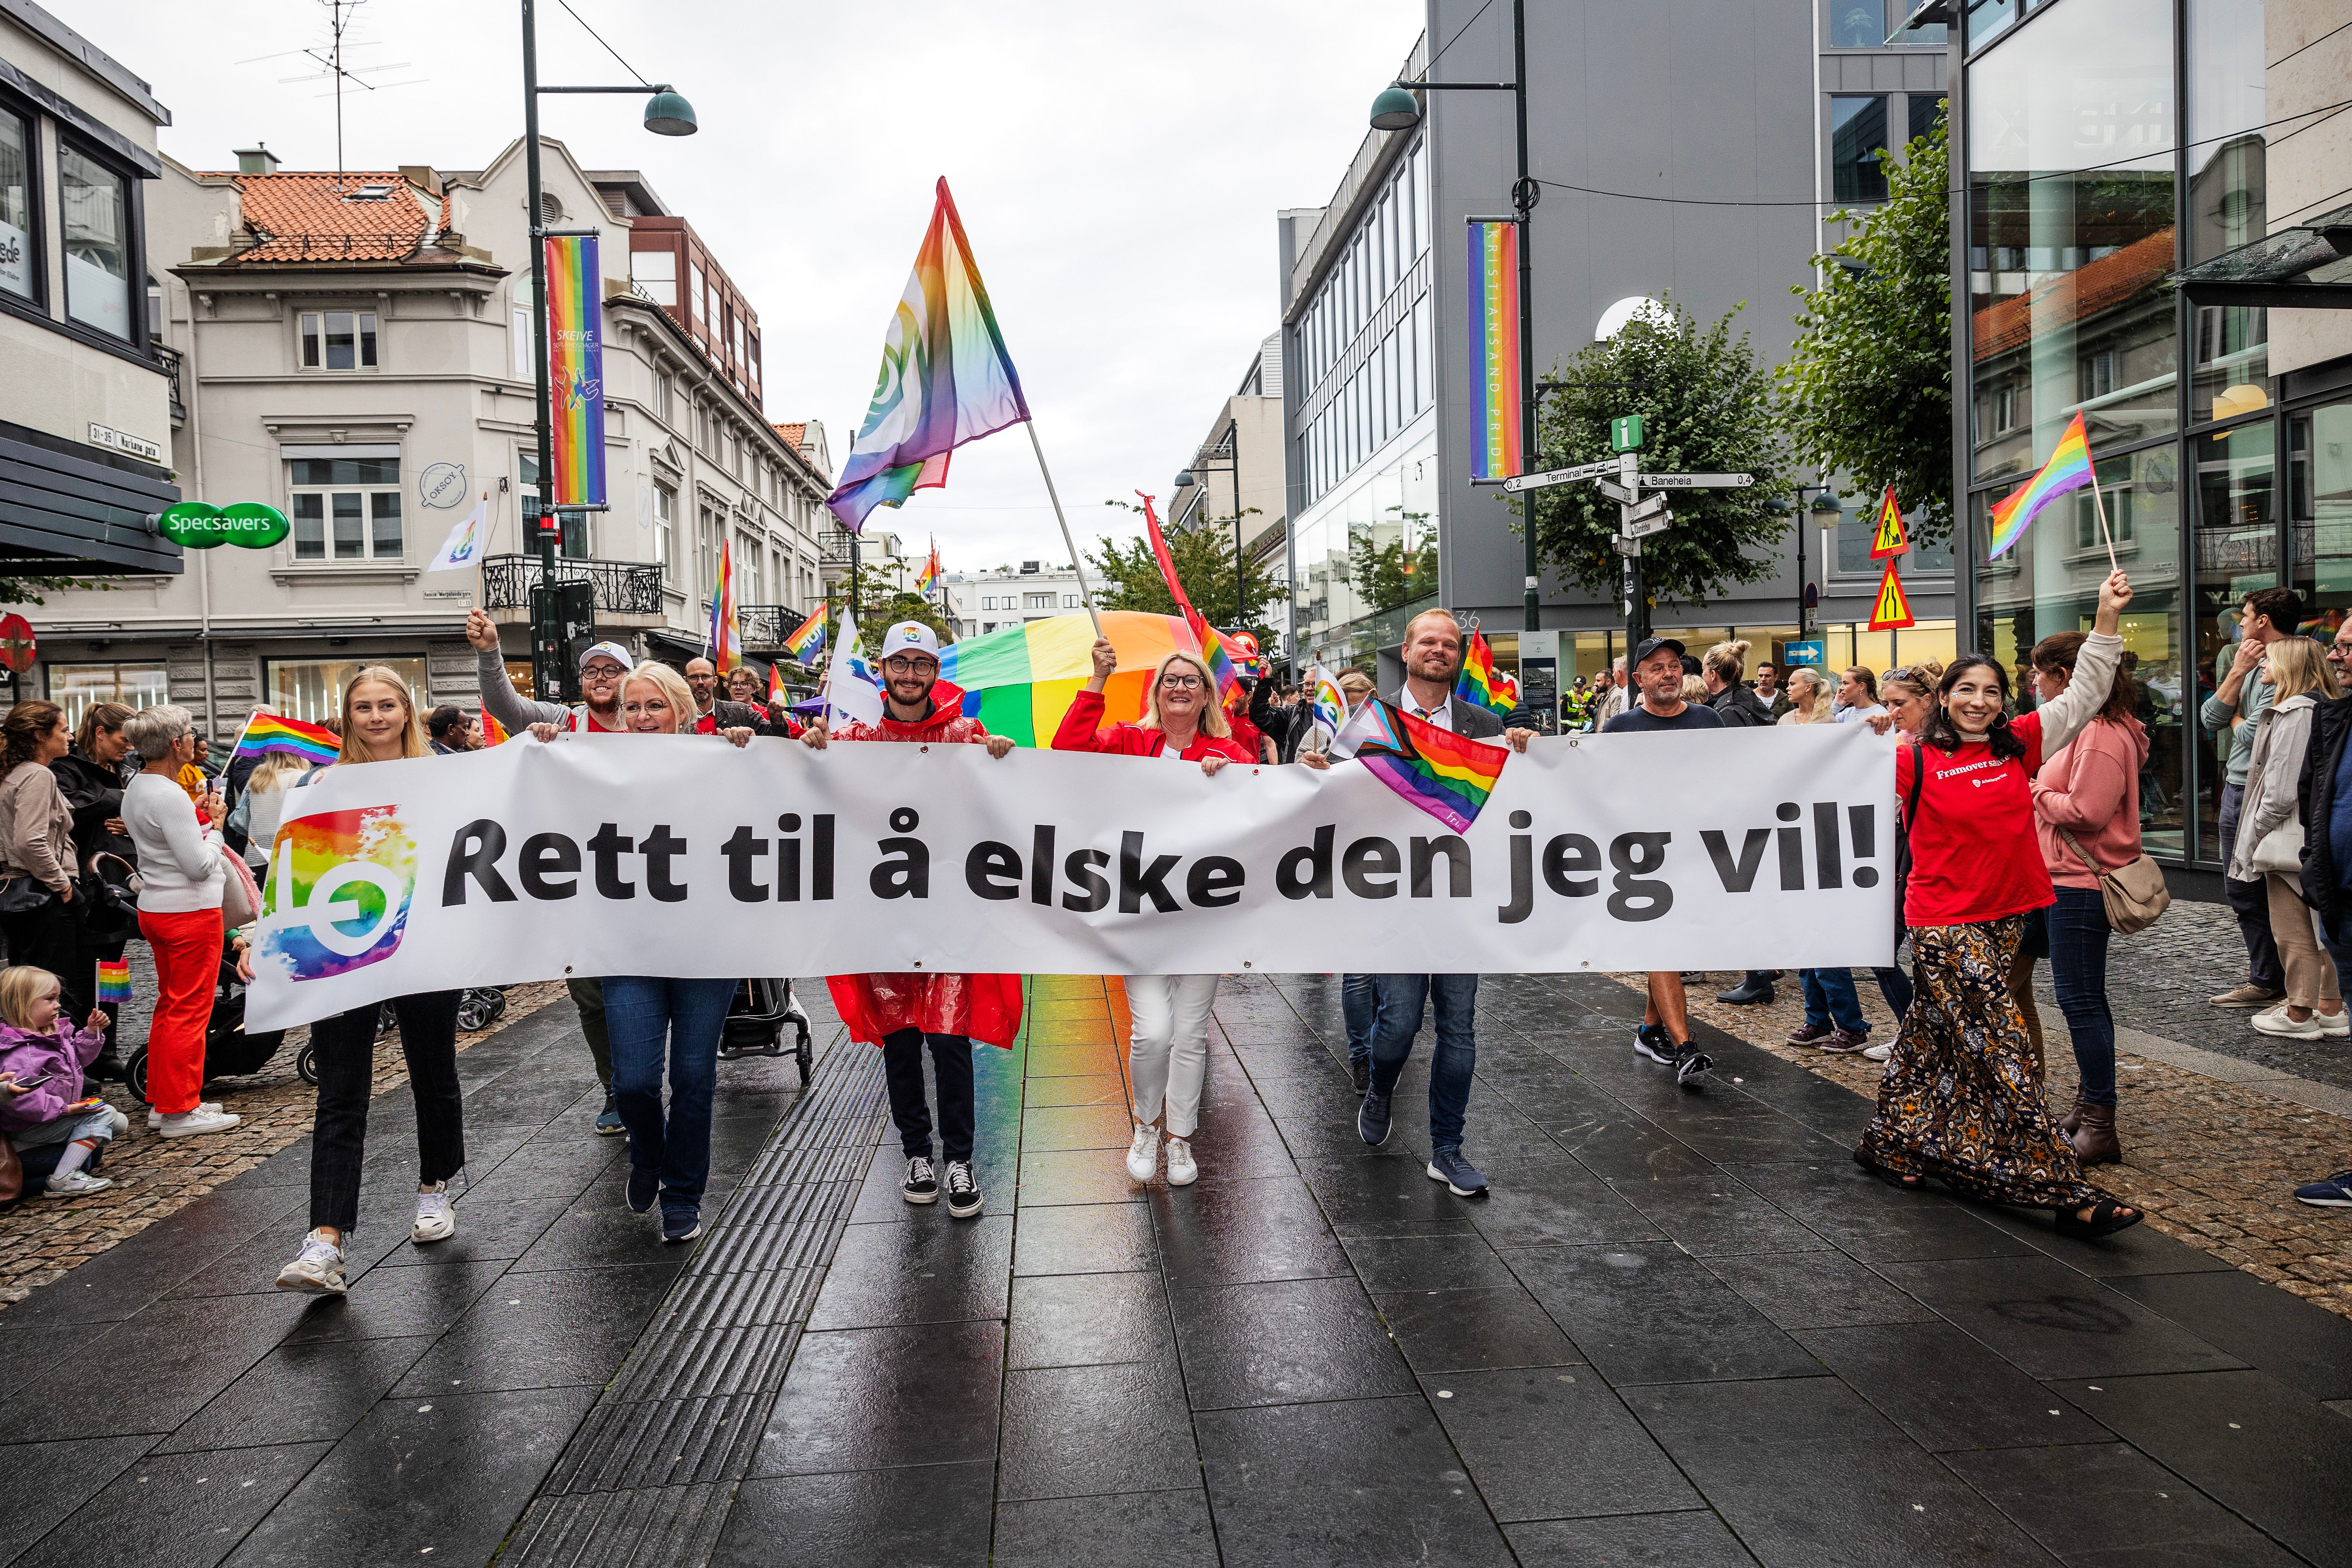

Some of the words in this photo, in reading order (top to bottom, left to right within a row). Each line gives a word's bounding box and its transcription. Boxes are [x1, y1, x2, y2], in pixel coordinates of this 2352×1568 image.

[1487, 230, 1500, 393] KRISTIANSAND
[557, 330, 593, 341] SKEIVE
[1490, 409, 1501, 470] PRIDE
[1507, 479, 1522, 490] 0,2
[1546, 468, 1582, 483] Terminal
[1651, 476, 1692, 486] Baneheia
[1737, 475, 1752, 486] 0,4
[169, 514, 270, 534] Specsavers
[1456, 610, 1480, 629] 36
[1936, 761, 1988, 780] Framover
[442, 819, 688, 907] Rett
[720, 813, 835, 903] til
[869, 807, 930, 900] å
[965, 824, 1246, 914] elske
[1275, 824, 1472, 900] den
[1498, 810, 1673, 924] jeg
[1699, 802, 1879, 893] vil!
